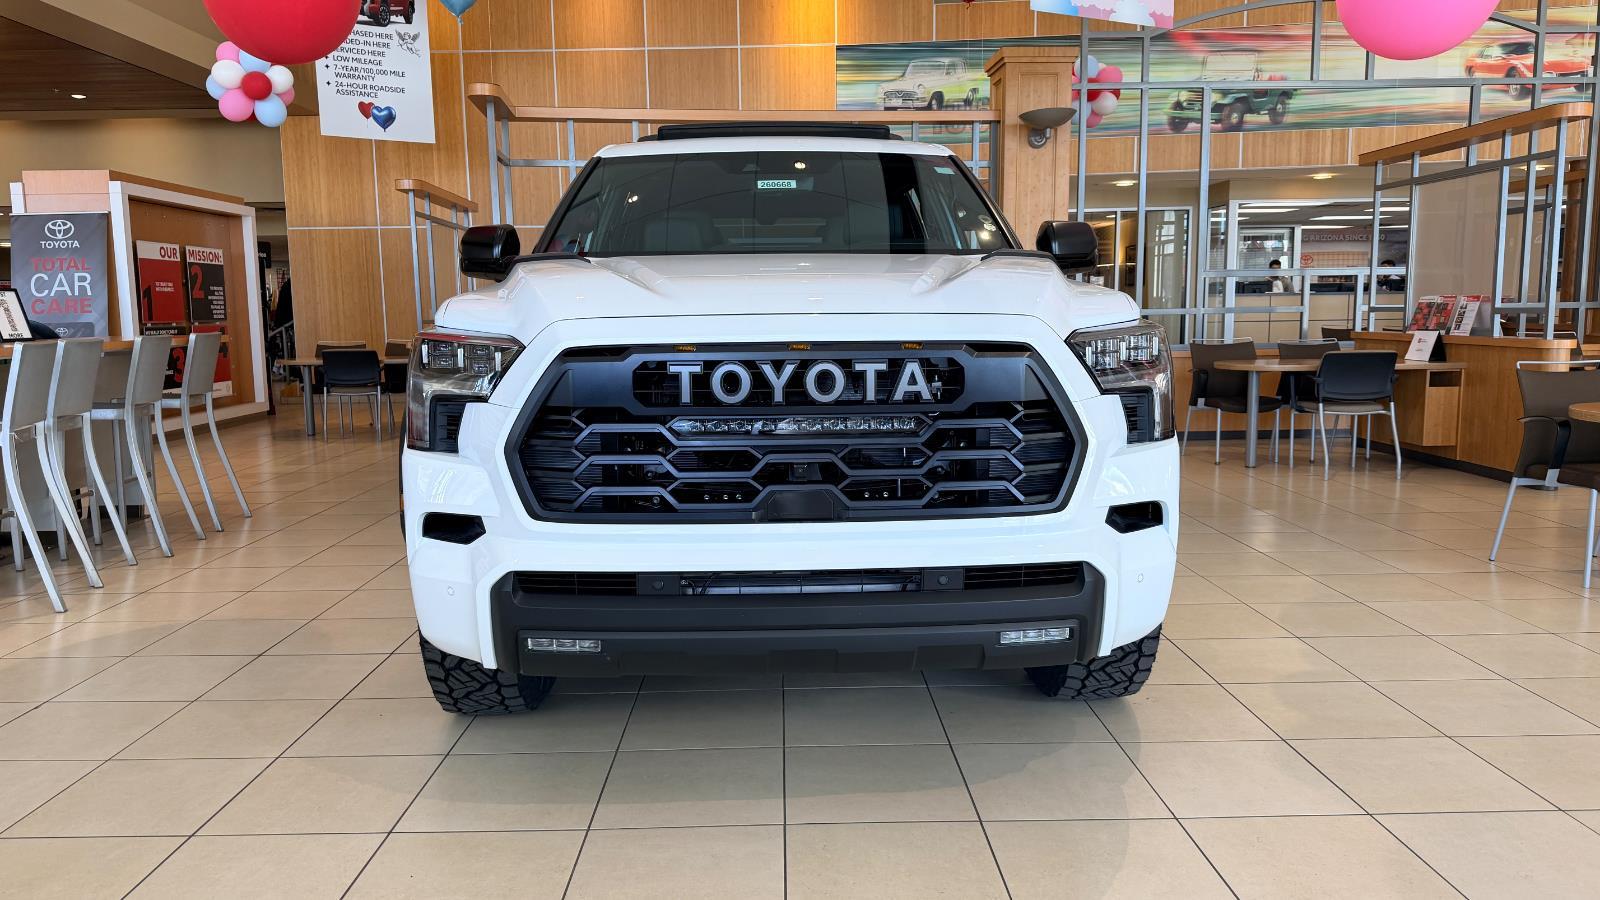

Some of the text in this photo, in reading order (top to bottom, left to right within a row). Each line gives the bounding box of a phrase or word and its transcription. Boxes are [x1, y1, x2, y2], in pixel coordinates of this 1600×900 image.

[350, 30, 394, 40] HASED HERE
[344, 38, 391, 49] DED-IN HERE
[336, 46, 367, 56] ERVICED
[333, 55, 383, 66] LOW MILEAGE
[334, 64, 406, 78] 7-YEAR/100,000 MILE
[334, 71, 376, 82] WARRANTY
[335, 81, 406, 94] 24-HOUR ROADSIDE
[336, 88, 379, 99] ASSISTANCE
[1310, 233, 1345, 241] ARIZONA
[1345, 233, 1368, 241] SINCE
[40, 240, 80, 249] TOYOTA
[159, 246, 223, 264] OUR MISSION:
[32, 257, 92, 272] TOTAL
[30, 272, 92, 297] CAR
[191, 264, 205, 299] 2
[31, 299, 92, 315] CARE
[667, 359, 934, 405] TOYOTA
